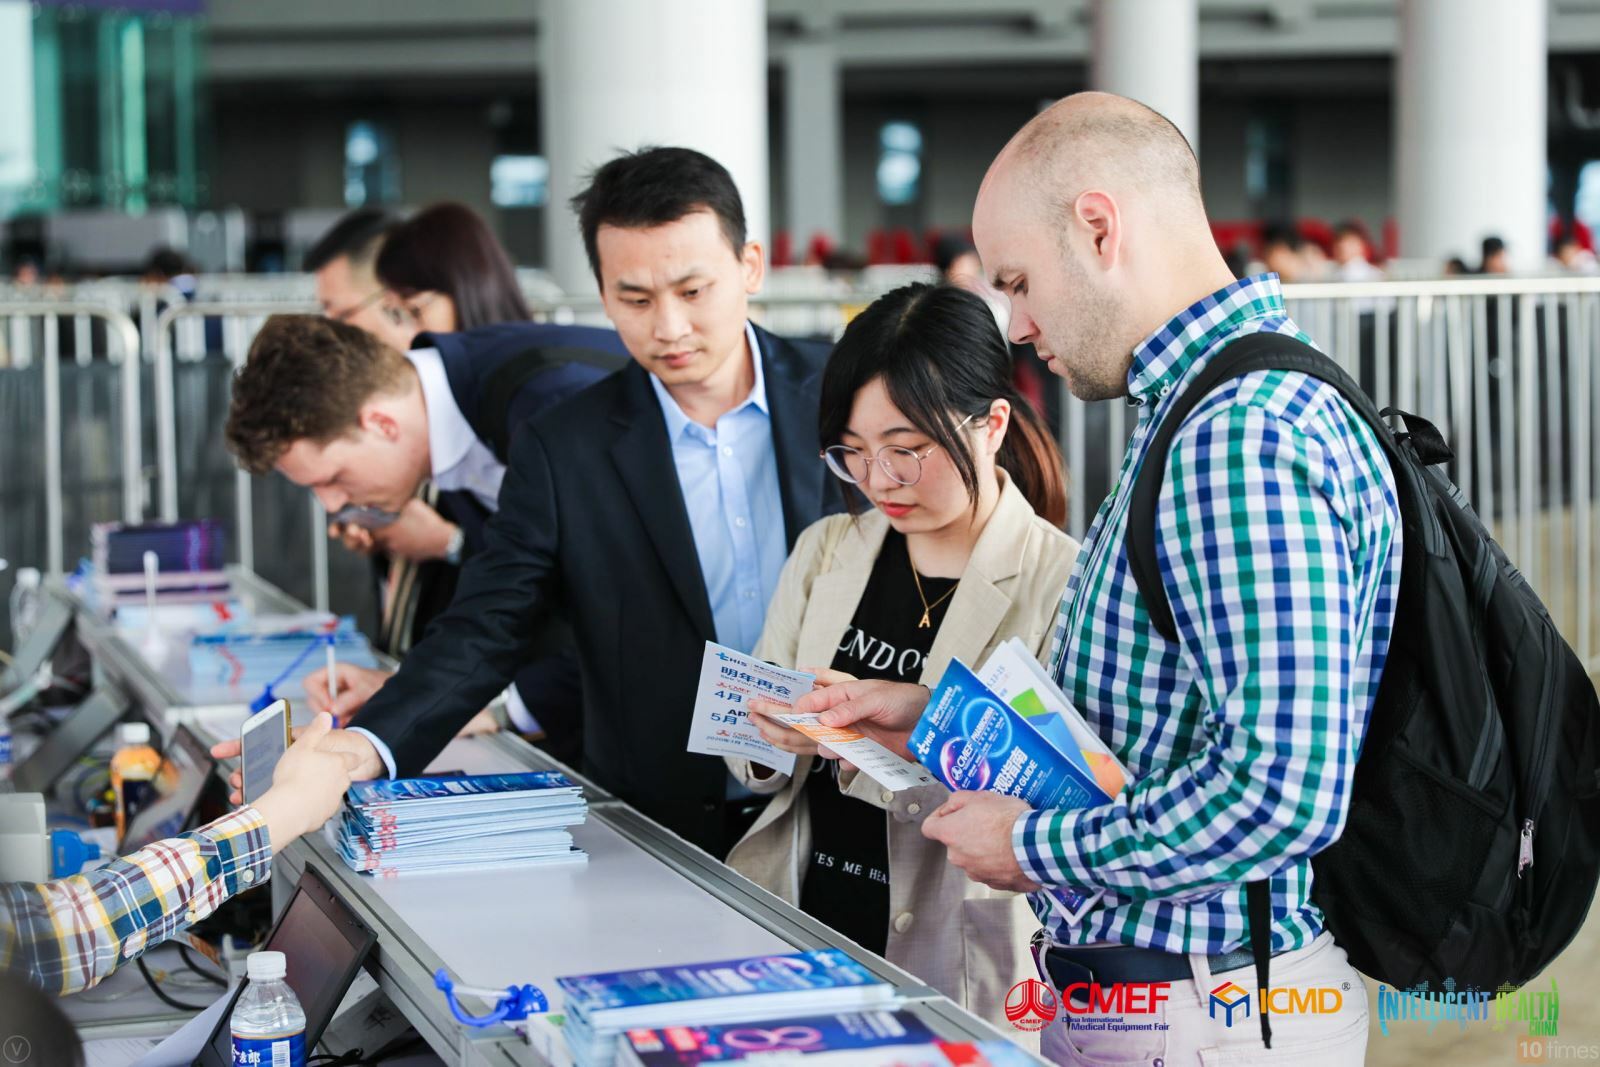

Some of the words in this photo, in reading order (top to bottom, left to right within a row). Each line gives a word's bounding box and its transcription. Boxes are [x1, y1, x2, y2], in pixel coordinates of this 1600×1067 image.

[838, 625, 929, 676] NDO
[721, 666, 791, 696] 明年再会
[714, 690, 742, 703] 4月
[711, 712, 737, 725] 5月
[957, 740, 974, 767] CMEF
[1018, 759, 1038, 787] GUIDE
[815, 852, 835, 867] ES
[842, 861, 863, 876] ME
[869, 867, 891, 885] HEA
